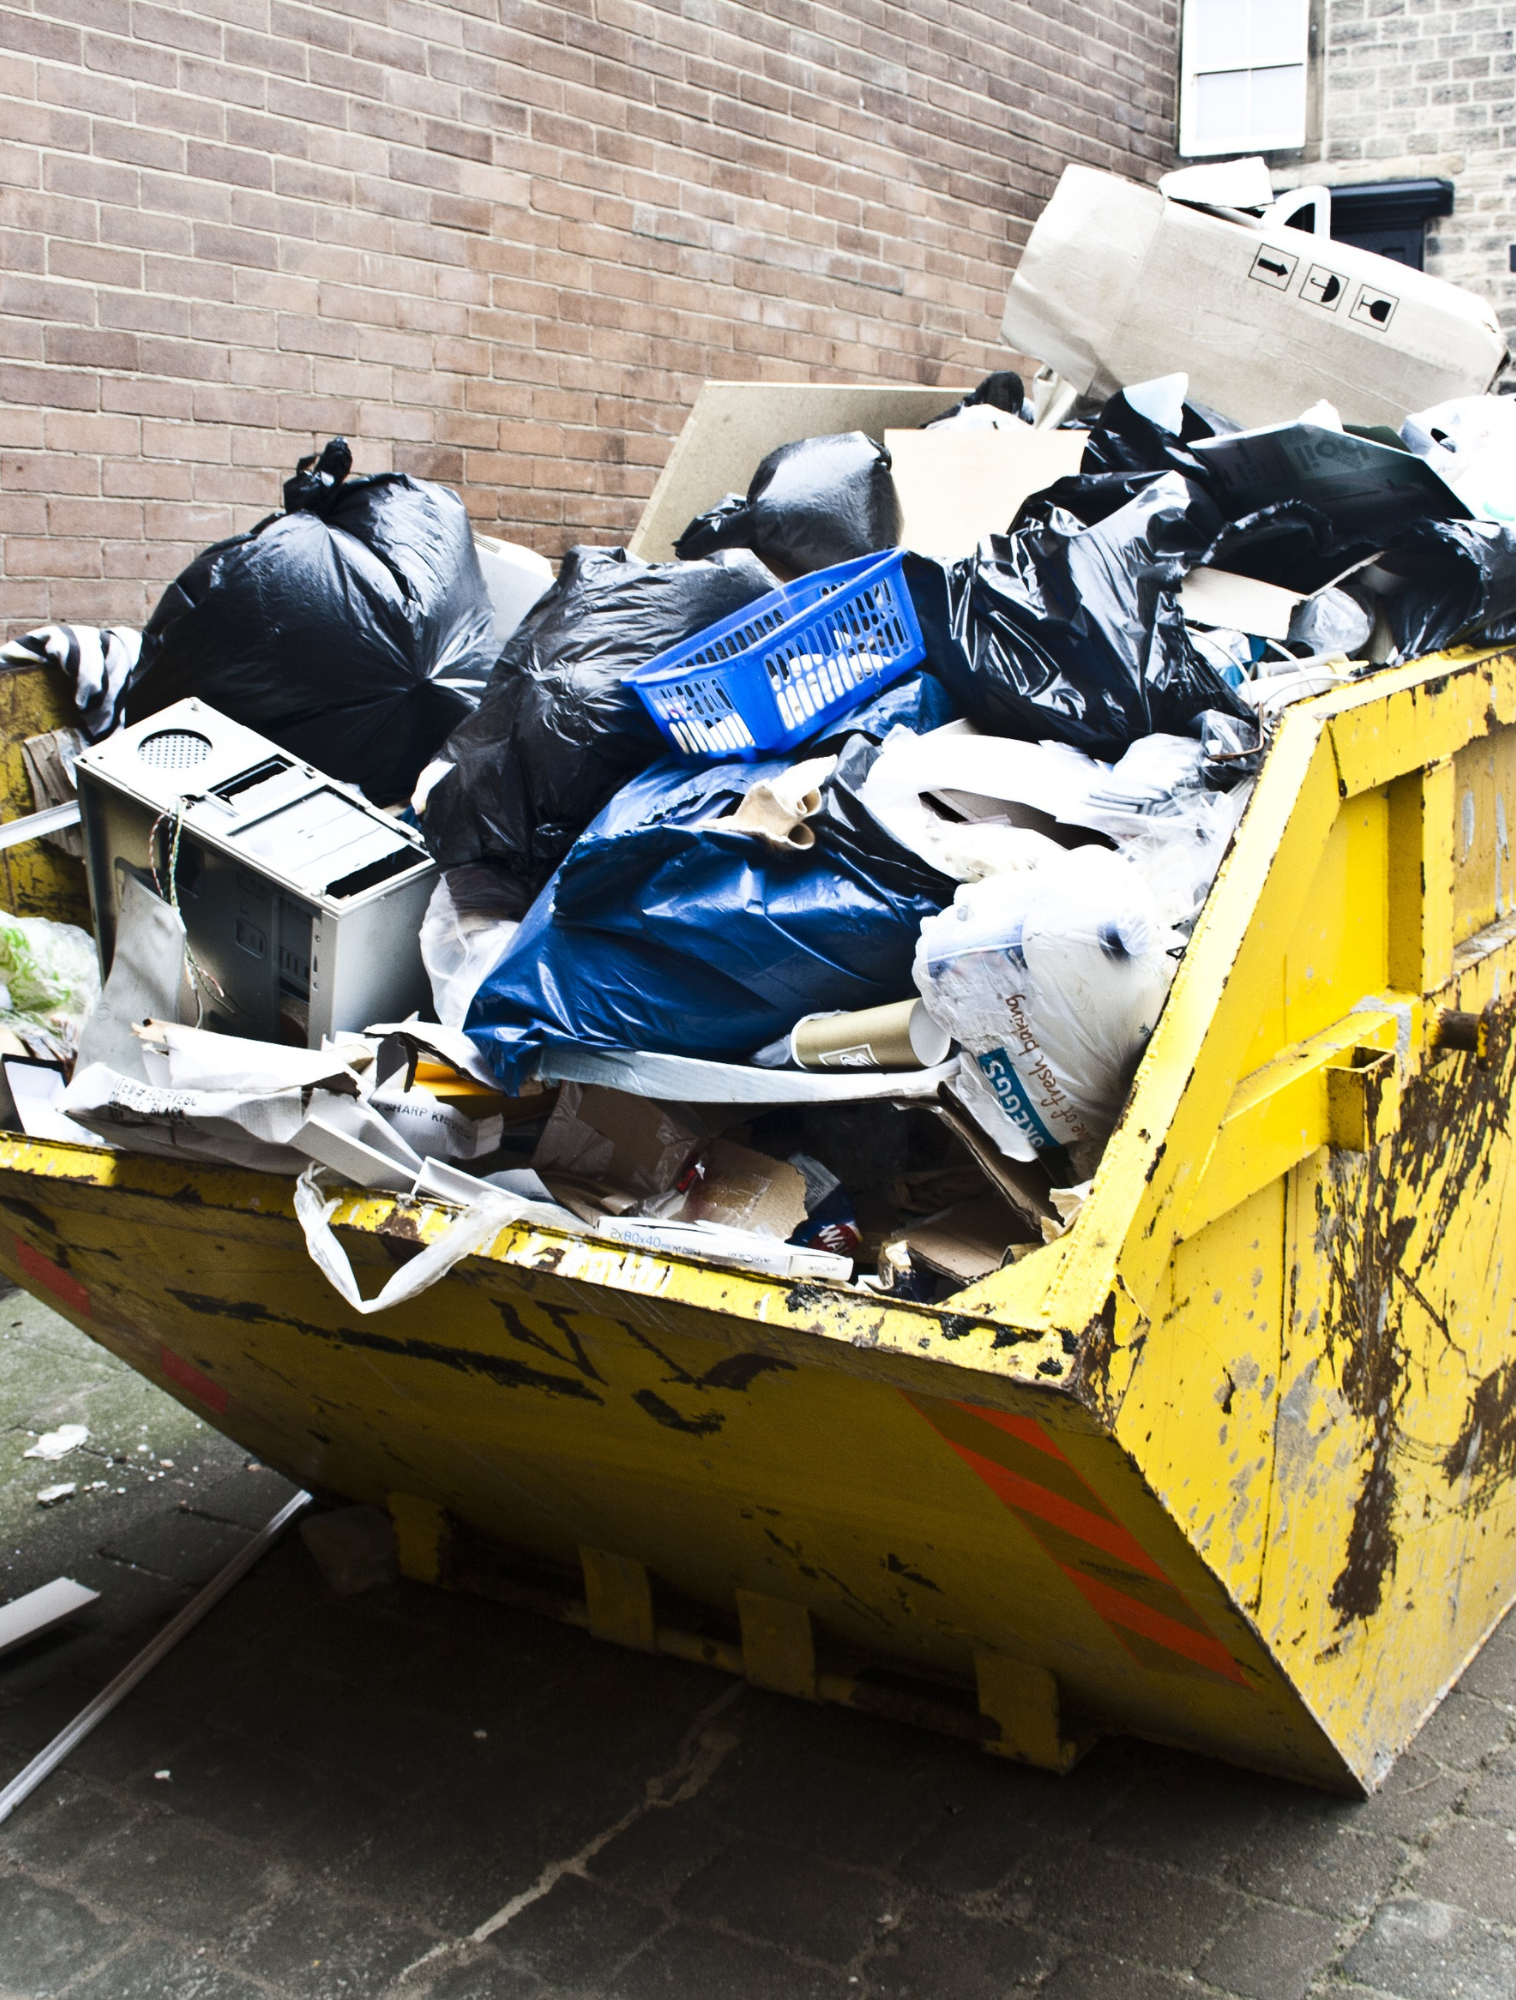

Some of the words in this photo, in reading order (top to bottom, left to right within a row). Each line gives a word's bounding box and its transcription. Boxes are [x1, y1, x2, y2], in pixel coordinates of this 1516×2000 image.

[1004, 994, 1040, 1057] baking
[1028, 1055, 1067, 1107] fresh
[383, 1103, 428, 1117] SHARP
[1051, 1105, 1078, 1124] of
